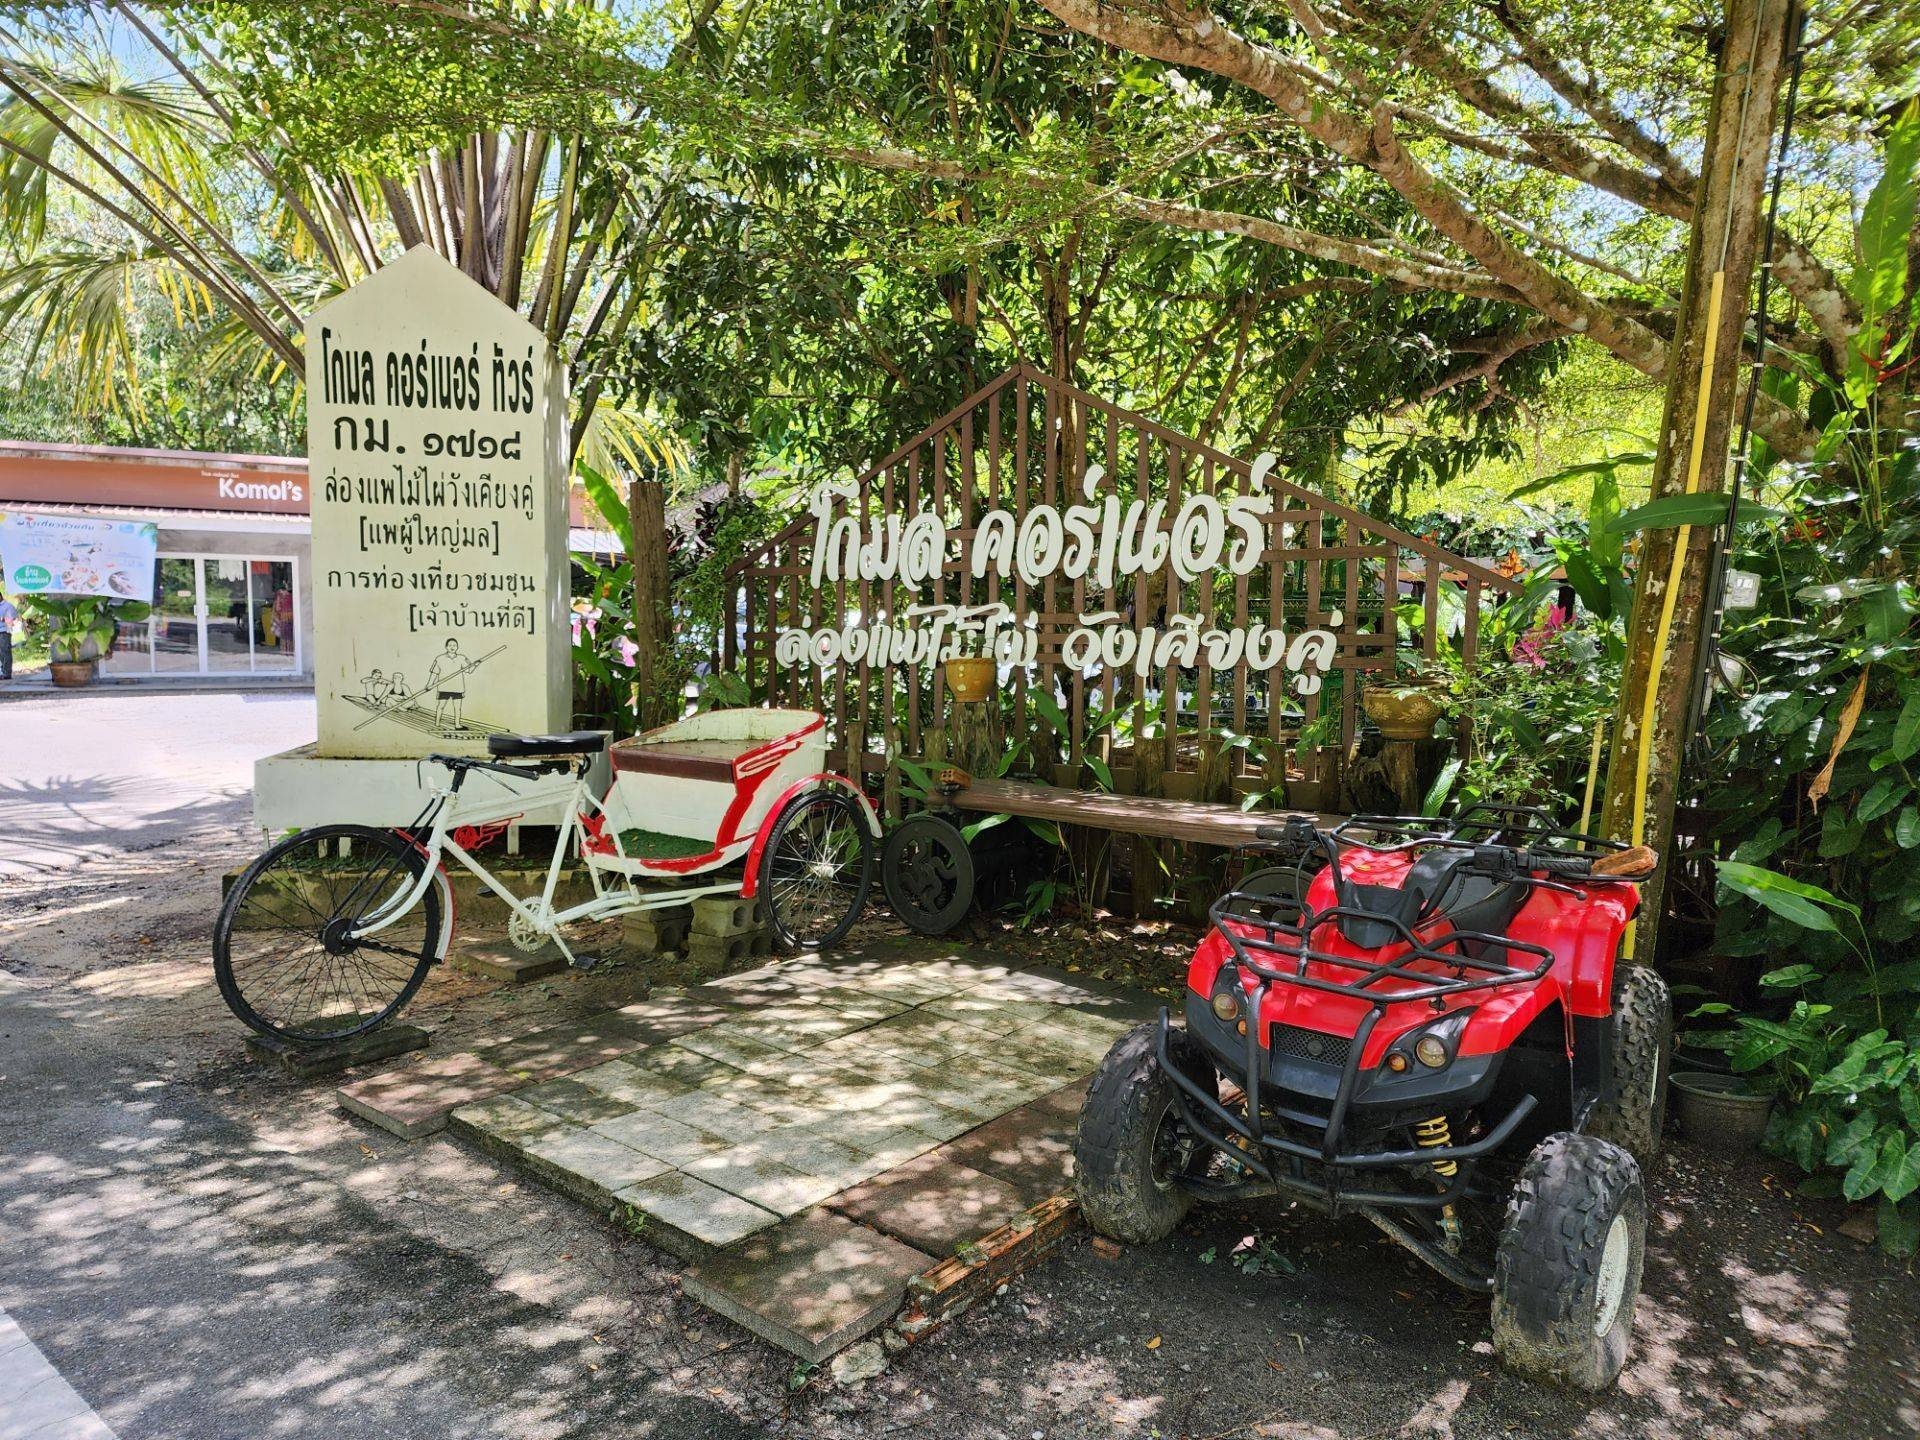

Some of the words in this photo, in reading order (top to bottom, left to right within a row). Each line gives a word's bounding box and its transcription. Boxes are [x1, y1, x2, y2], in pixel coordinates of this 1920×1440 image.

[321, 326, 375, 406] โกมล
[386, 338, 480, 412] คอร์เนอร์
[492, 342, 534, 415] ทัวร์
[333, 416, 406, 454] กม.
[423, 428, 521, 461] ๑๗๑๘
[219, 477, 304, 502] Komol's
[324, 464, 534, 521] ล่องแพไม้ไผ่วังเคียงคู่
[809, 479, 947, 592] โกมล
[970, 452, 1277, 589] คอร์เนอร์
[409, 599, 536, 635] [เจ้าบ้านที่ดี]
